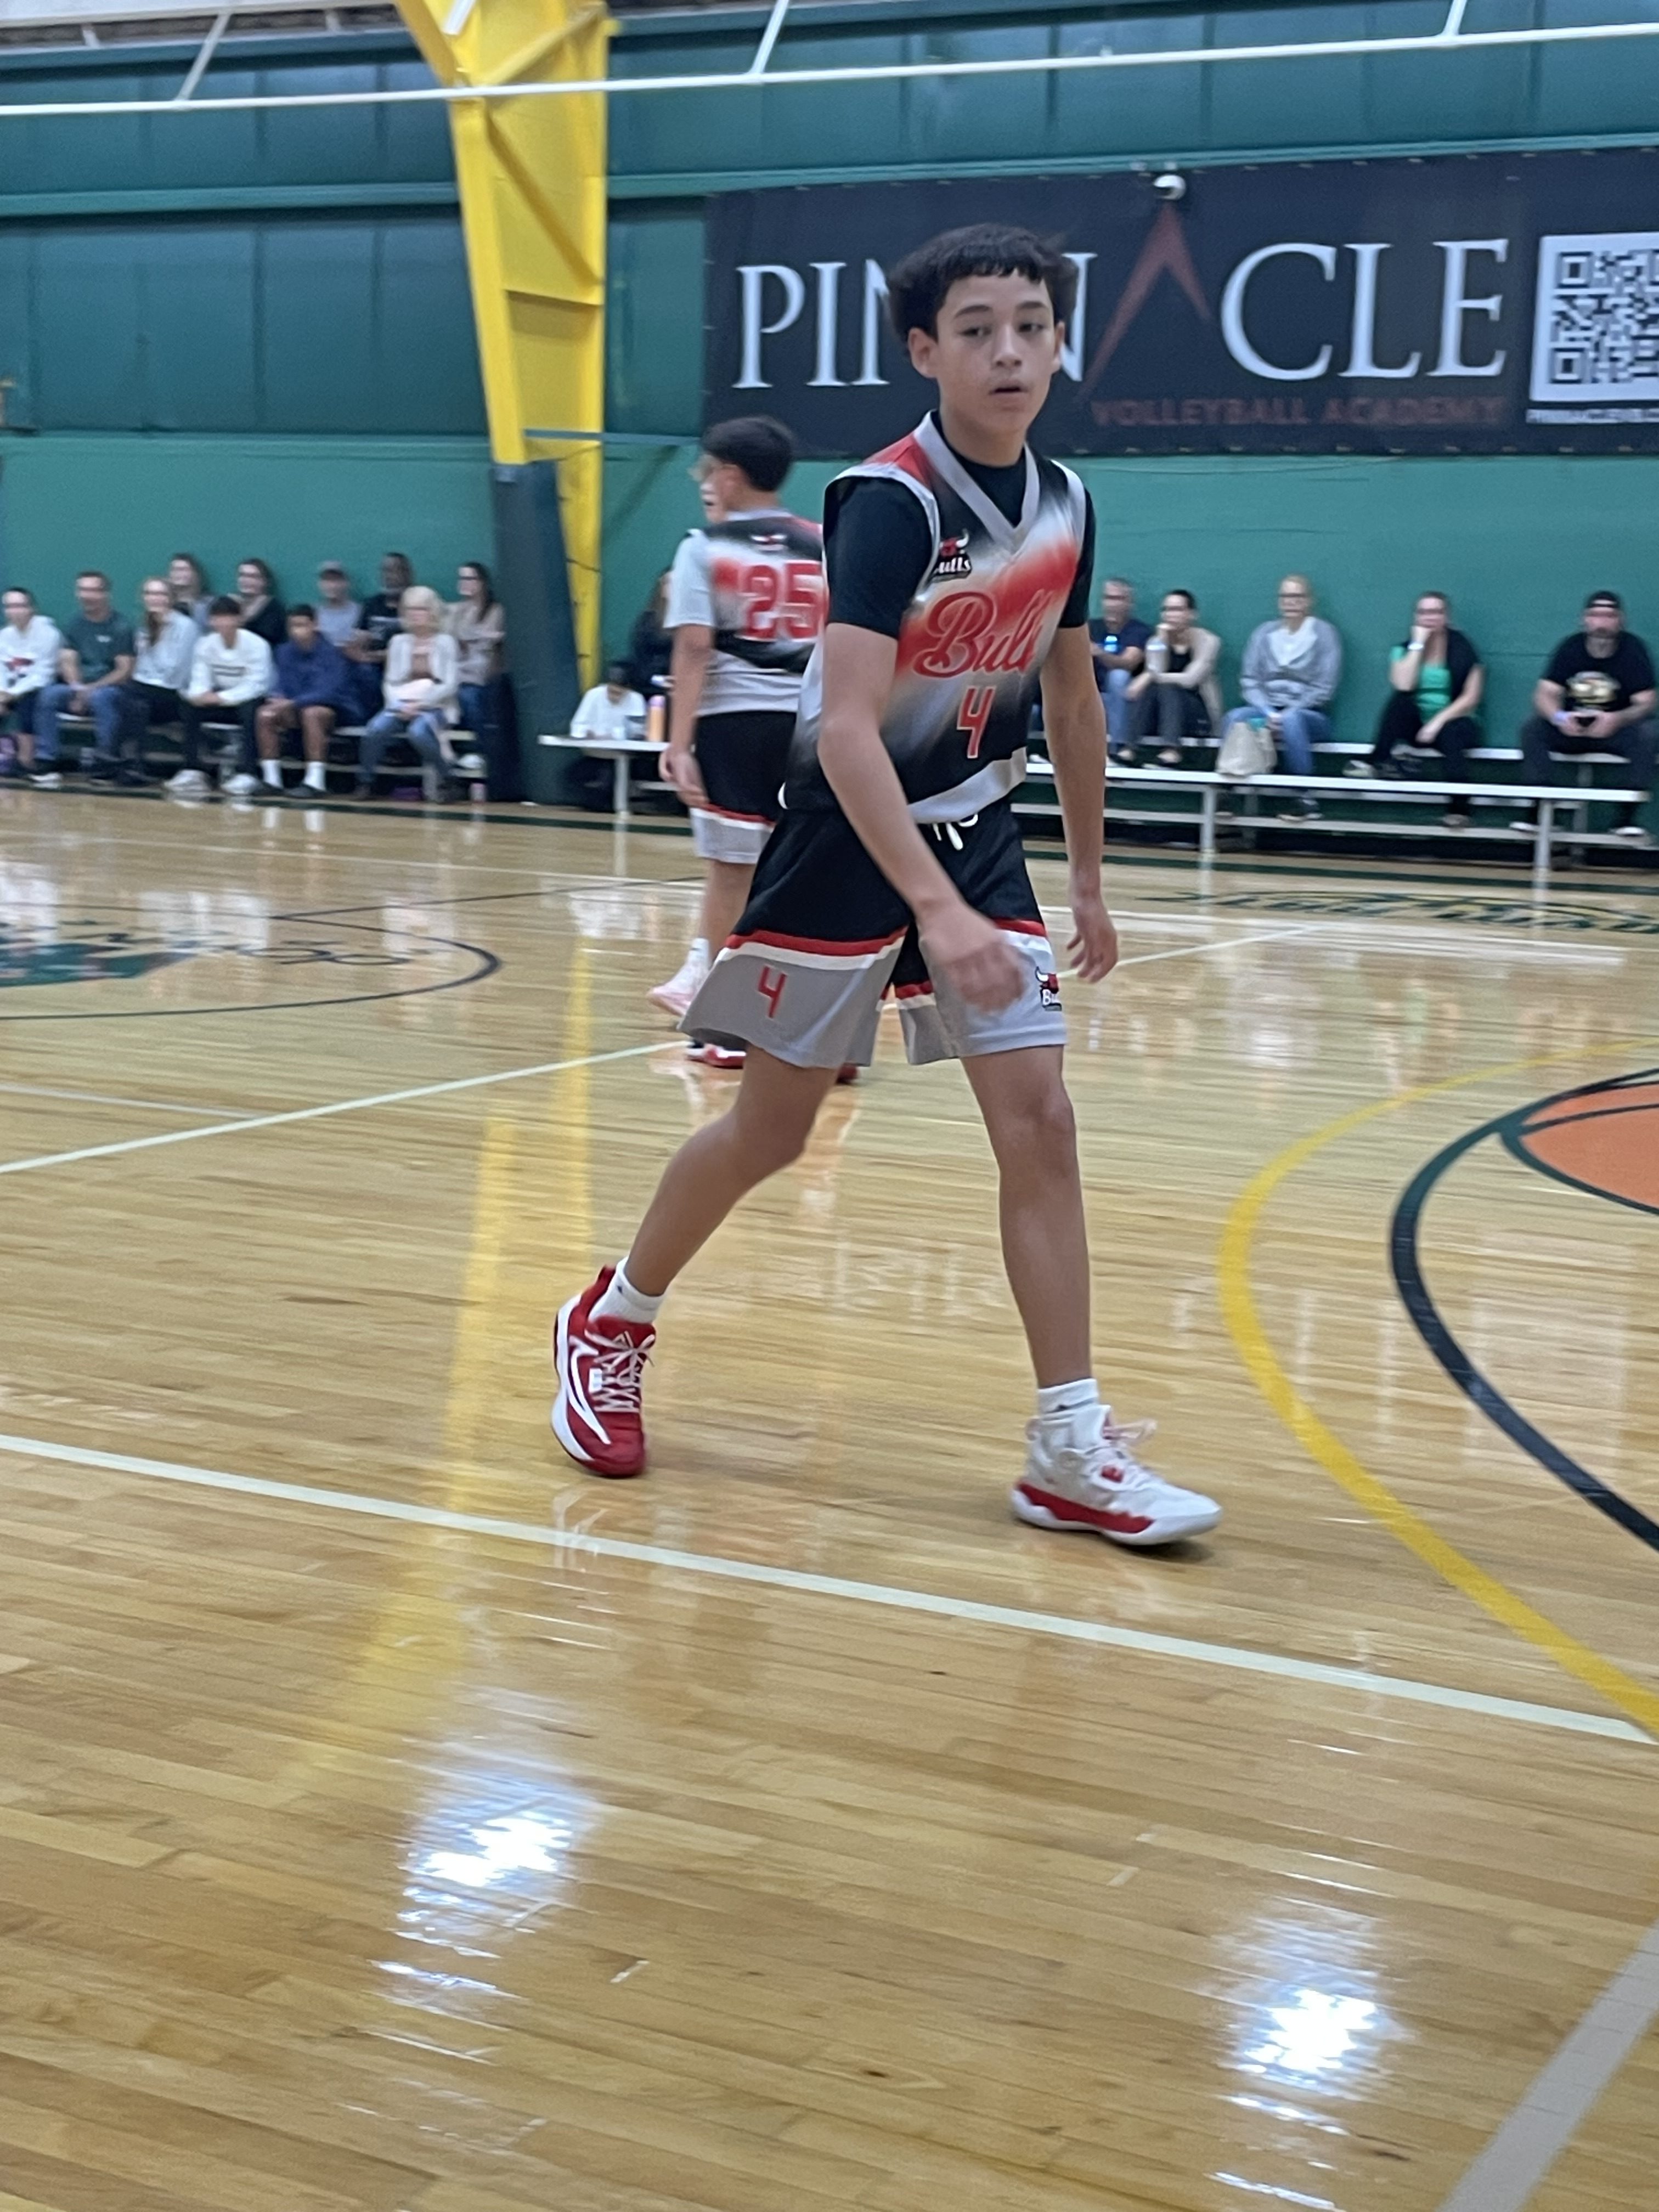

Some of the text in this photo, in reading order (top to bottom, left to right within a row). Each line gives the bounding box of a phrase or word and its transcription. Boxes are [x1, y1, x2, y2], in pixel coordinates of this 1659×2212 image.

[1091, 397, 1311, 426] VOLLEYBALL
[1321, 396, 1506, 426] ACADEMY
[933, 557, 971, 574] ulls
[738, 560, 830, 642] 25
[956, 685, 996, 759] 4
[757, 964, 788, 1019] 4
